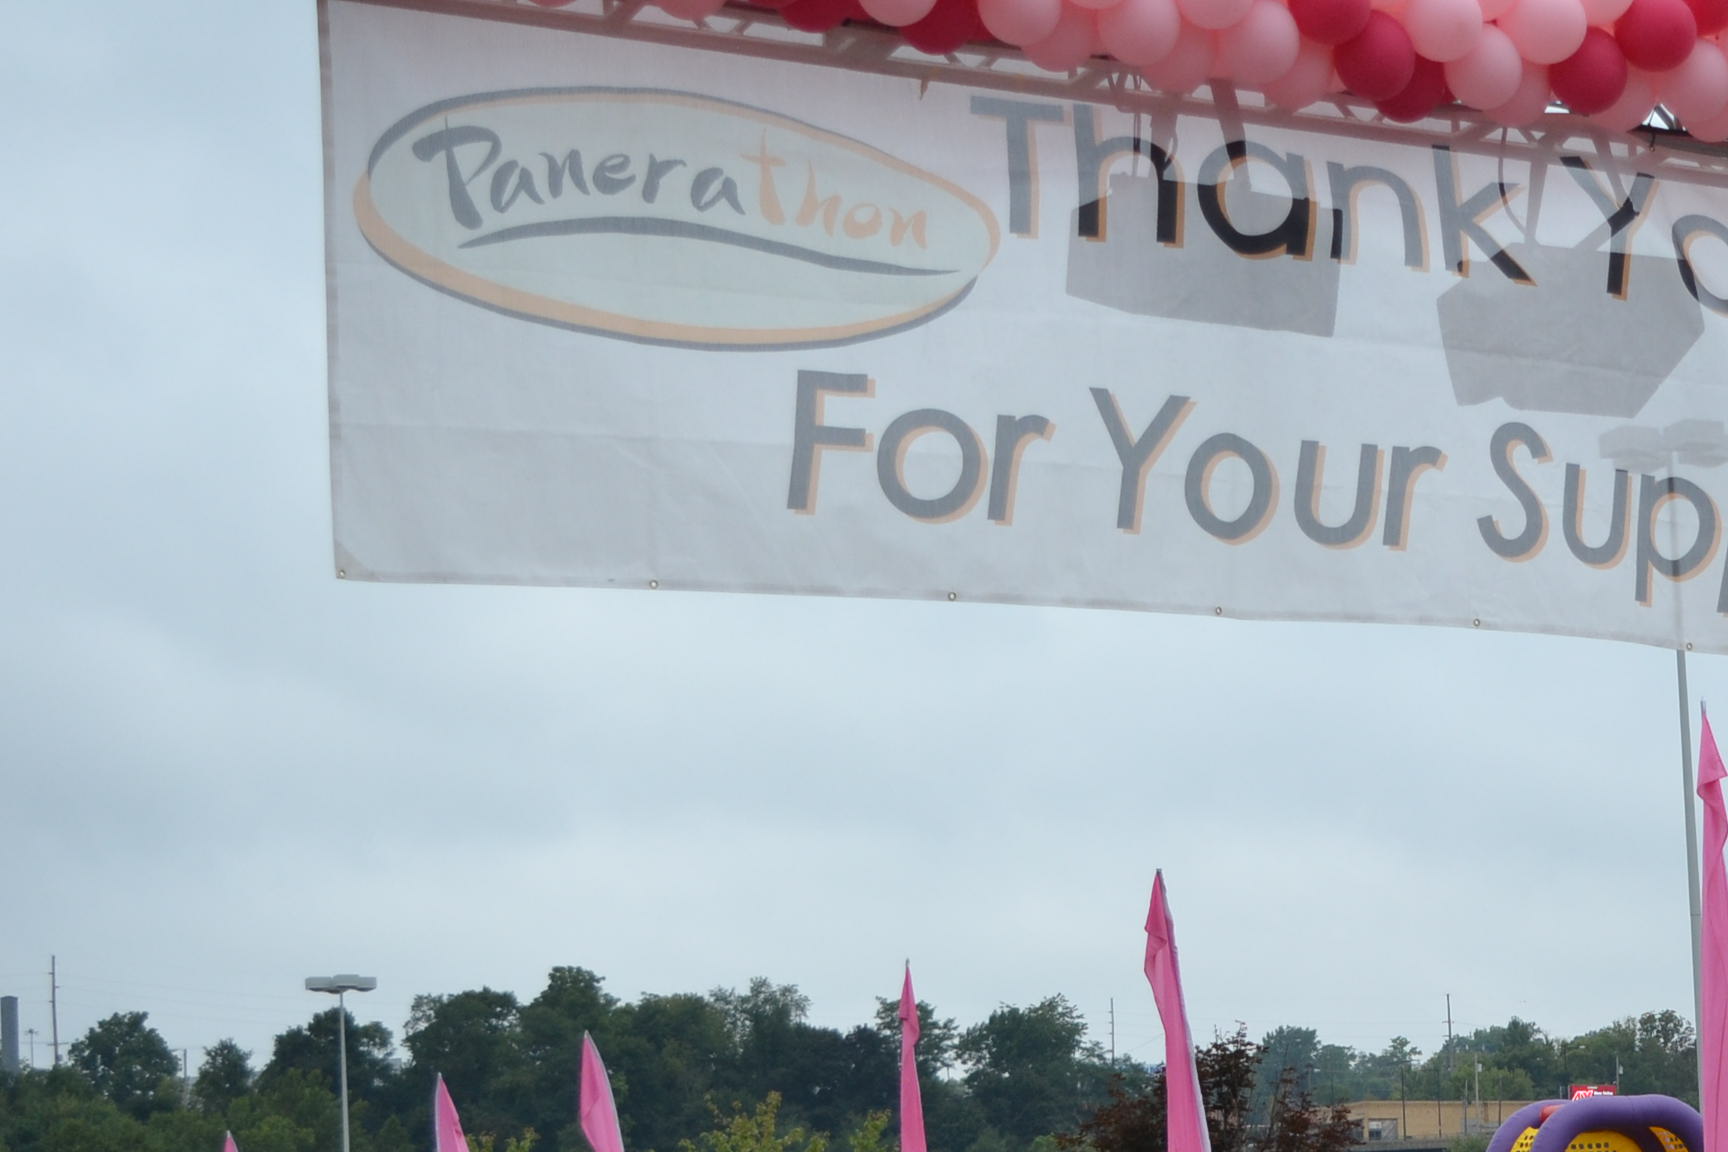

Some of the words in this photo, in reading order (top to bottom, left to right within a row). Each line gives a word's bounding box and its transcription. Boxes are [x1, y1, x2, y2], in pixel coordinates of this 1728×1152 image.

[970, 95, 1538, 287] Thank
[786, 369, 1056, 526] For
[1088, 386, 1448, 552] Your
